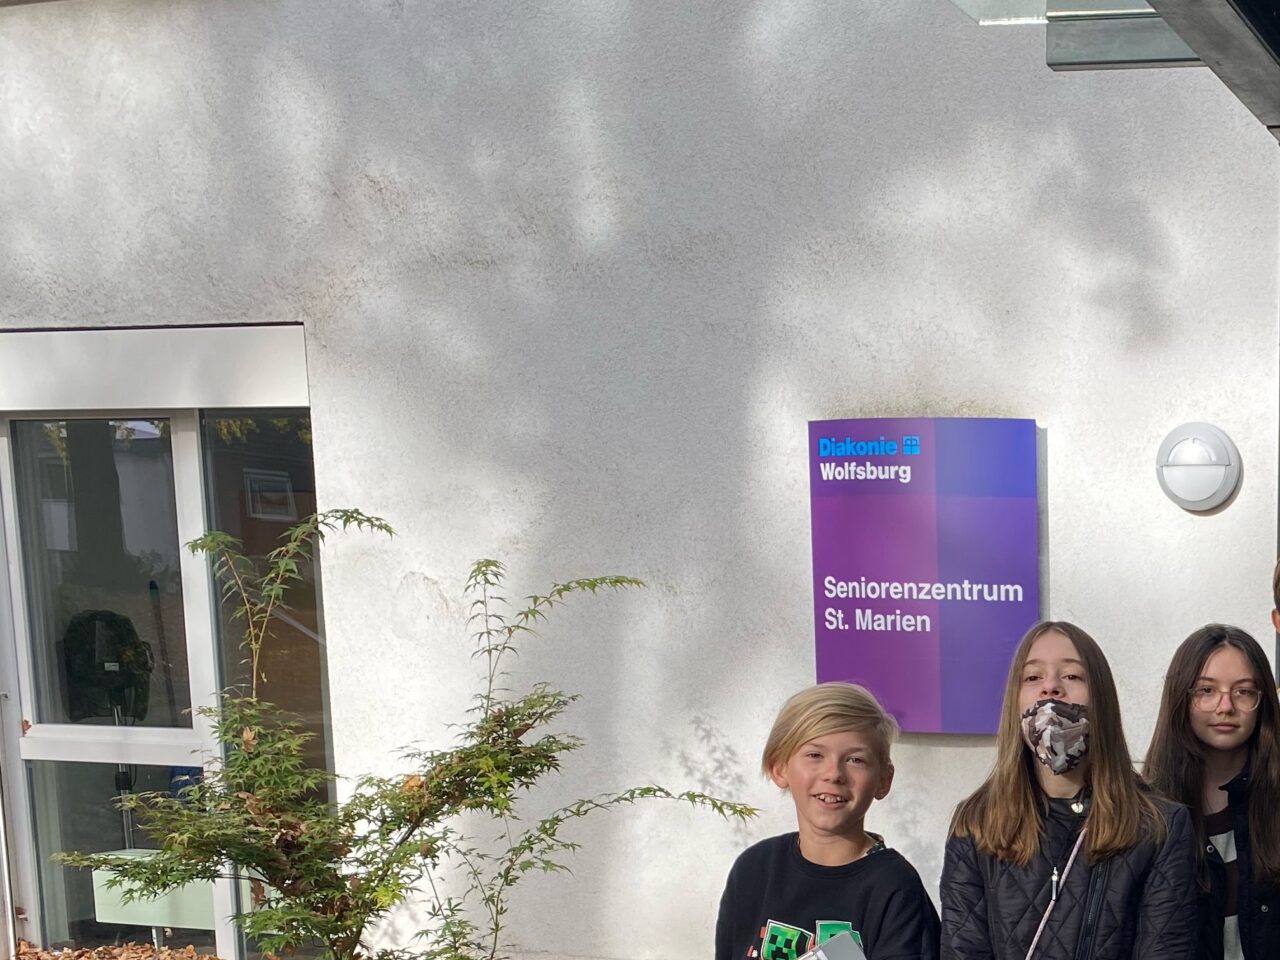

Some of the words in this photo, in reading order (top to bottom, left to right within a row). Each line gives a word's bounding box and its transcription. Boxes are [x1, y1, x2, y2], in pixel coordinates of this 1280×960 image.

[818, 436, 897, 456] Diakonie
[820, 462, 911, 483] Wolfsburg
[824, 576, 1023, 601] Seniorenzentrum
[824, 608, 849, 629] St.
[855, 609, 931, 632] Marien
